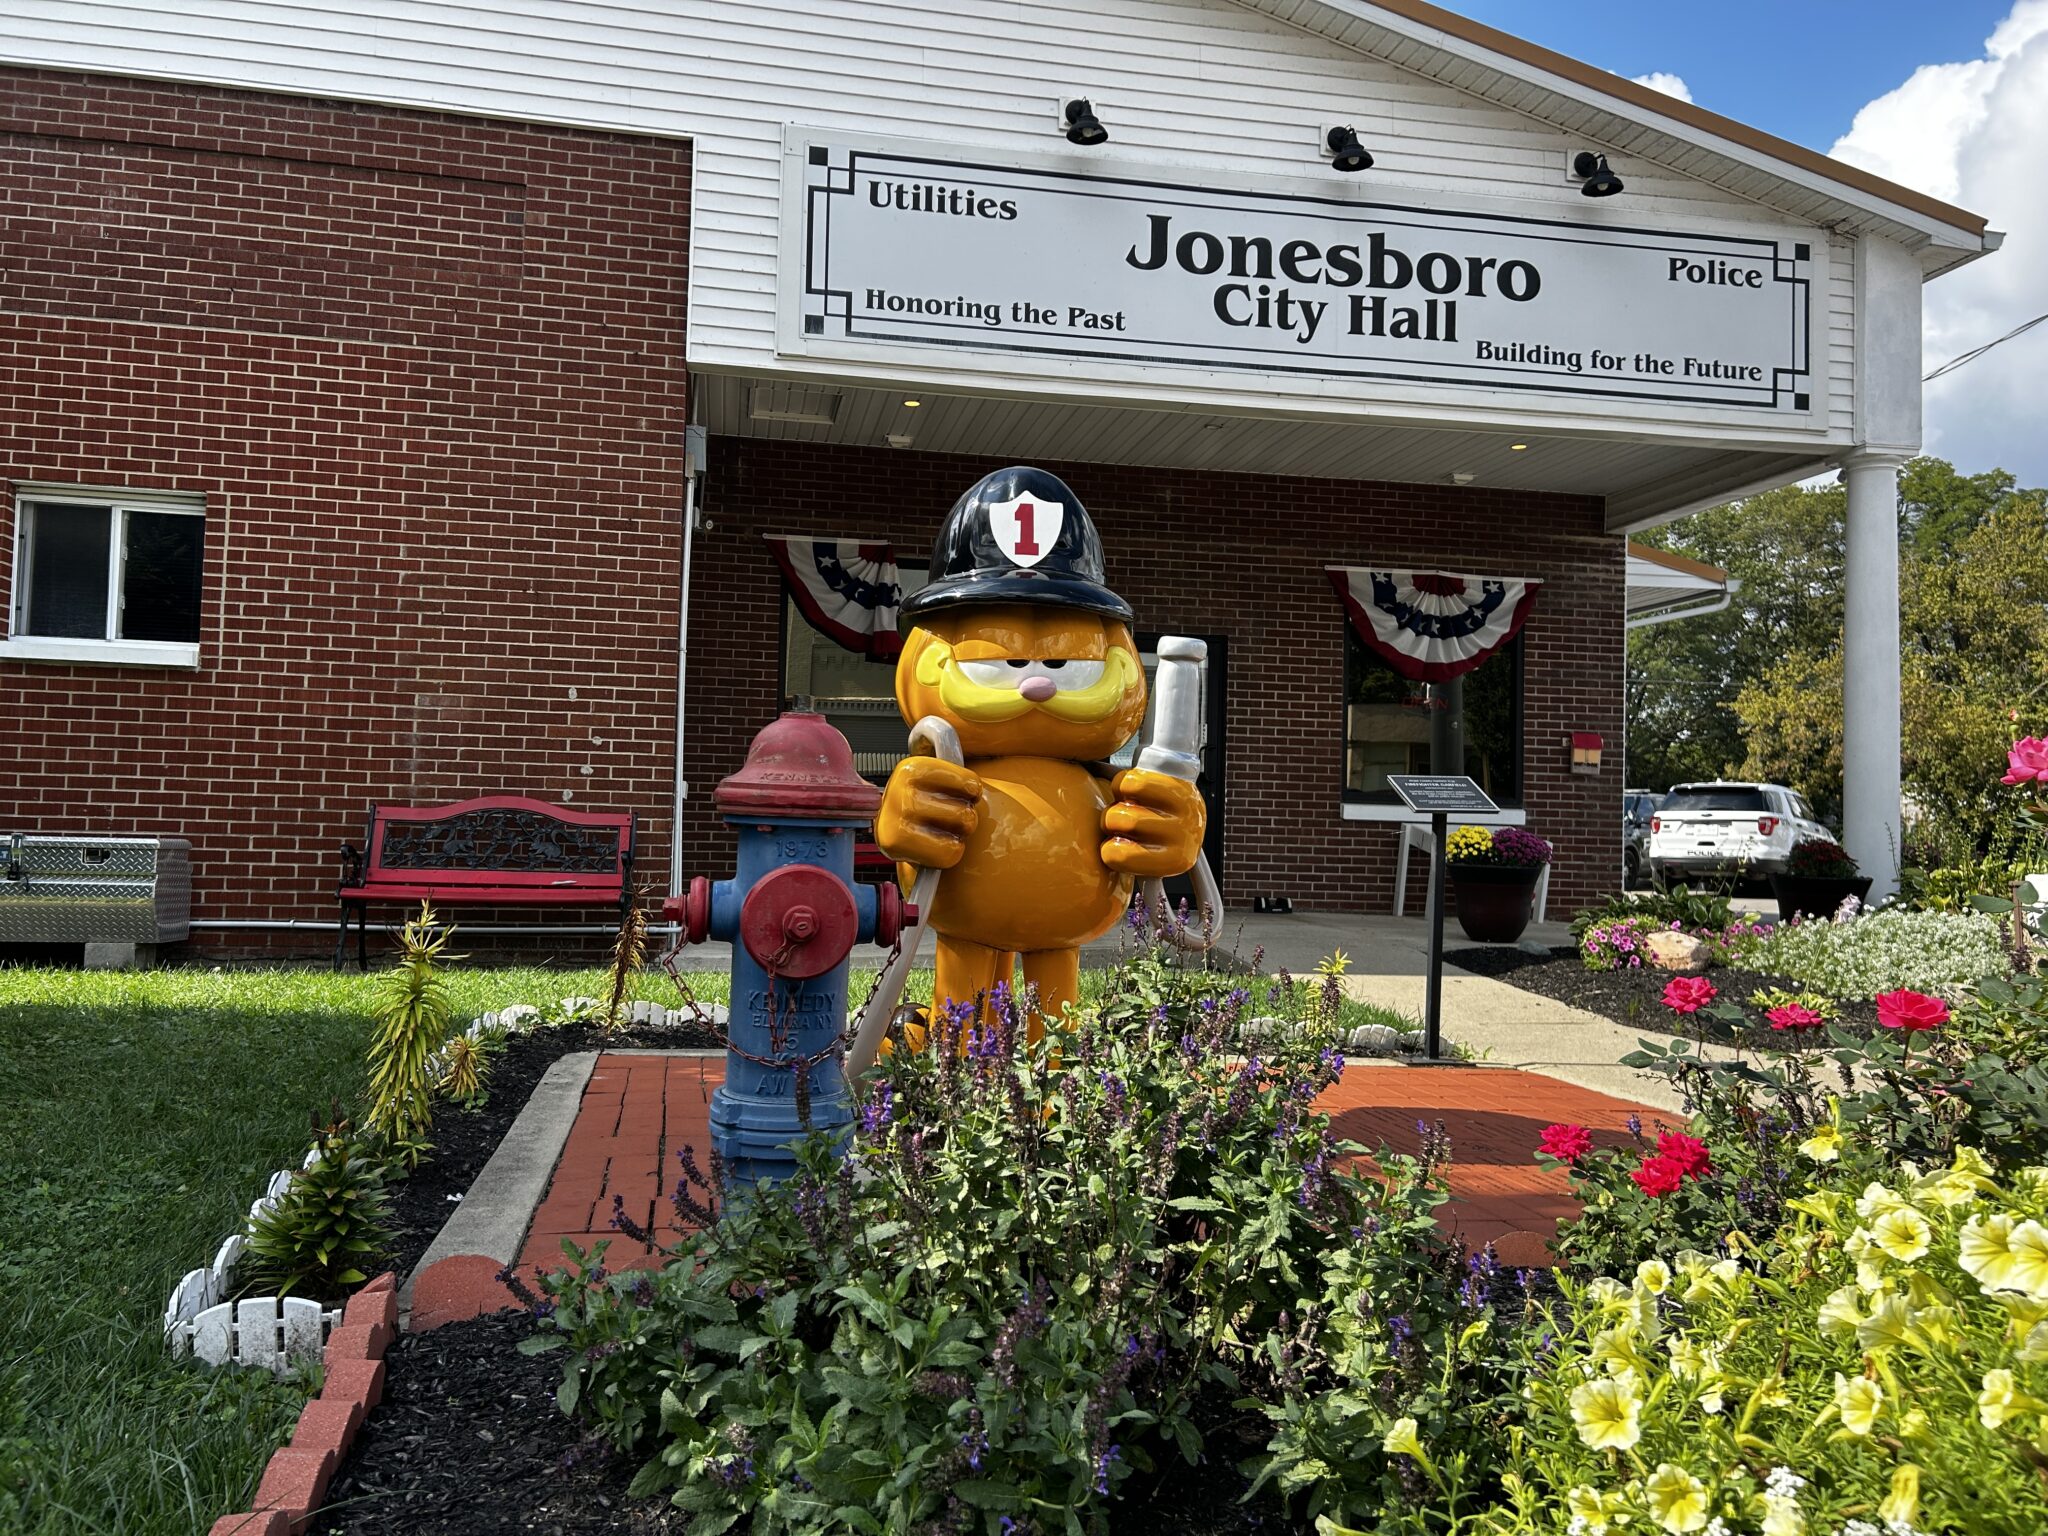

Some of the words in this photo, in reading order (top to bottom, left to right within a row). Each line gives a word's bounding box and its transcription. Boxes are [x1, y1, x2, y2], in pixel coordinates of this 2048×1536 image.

[868, 180, 1018, 221] Utilities
[1125, 213, 1541, 302] Jonesboro
[1667, 256, 1763, 289] Police
[865, 288, 1002, 326] Honoring
[1011, 301, 1058, 326] the
[1067, 306, 1126, 332] Past
[1213, 283, 1329, 344] City
[1347, 294, 1459, 343] Hall
[1475, 340, 1583, 373] Building
[1590, 349, 1627, 371] for
[1634, 353, 1675, 376] the
[1683, 357, 1763, 382] Future
[1014, 503, 1039, 556] 1
[1401, 696, 1449, 710] OPN
[752, 1013, 810, 1029] ELMRA
[755, 1073, 823, 1095] AWA
